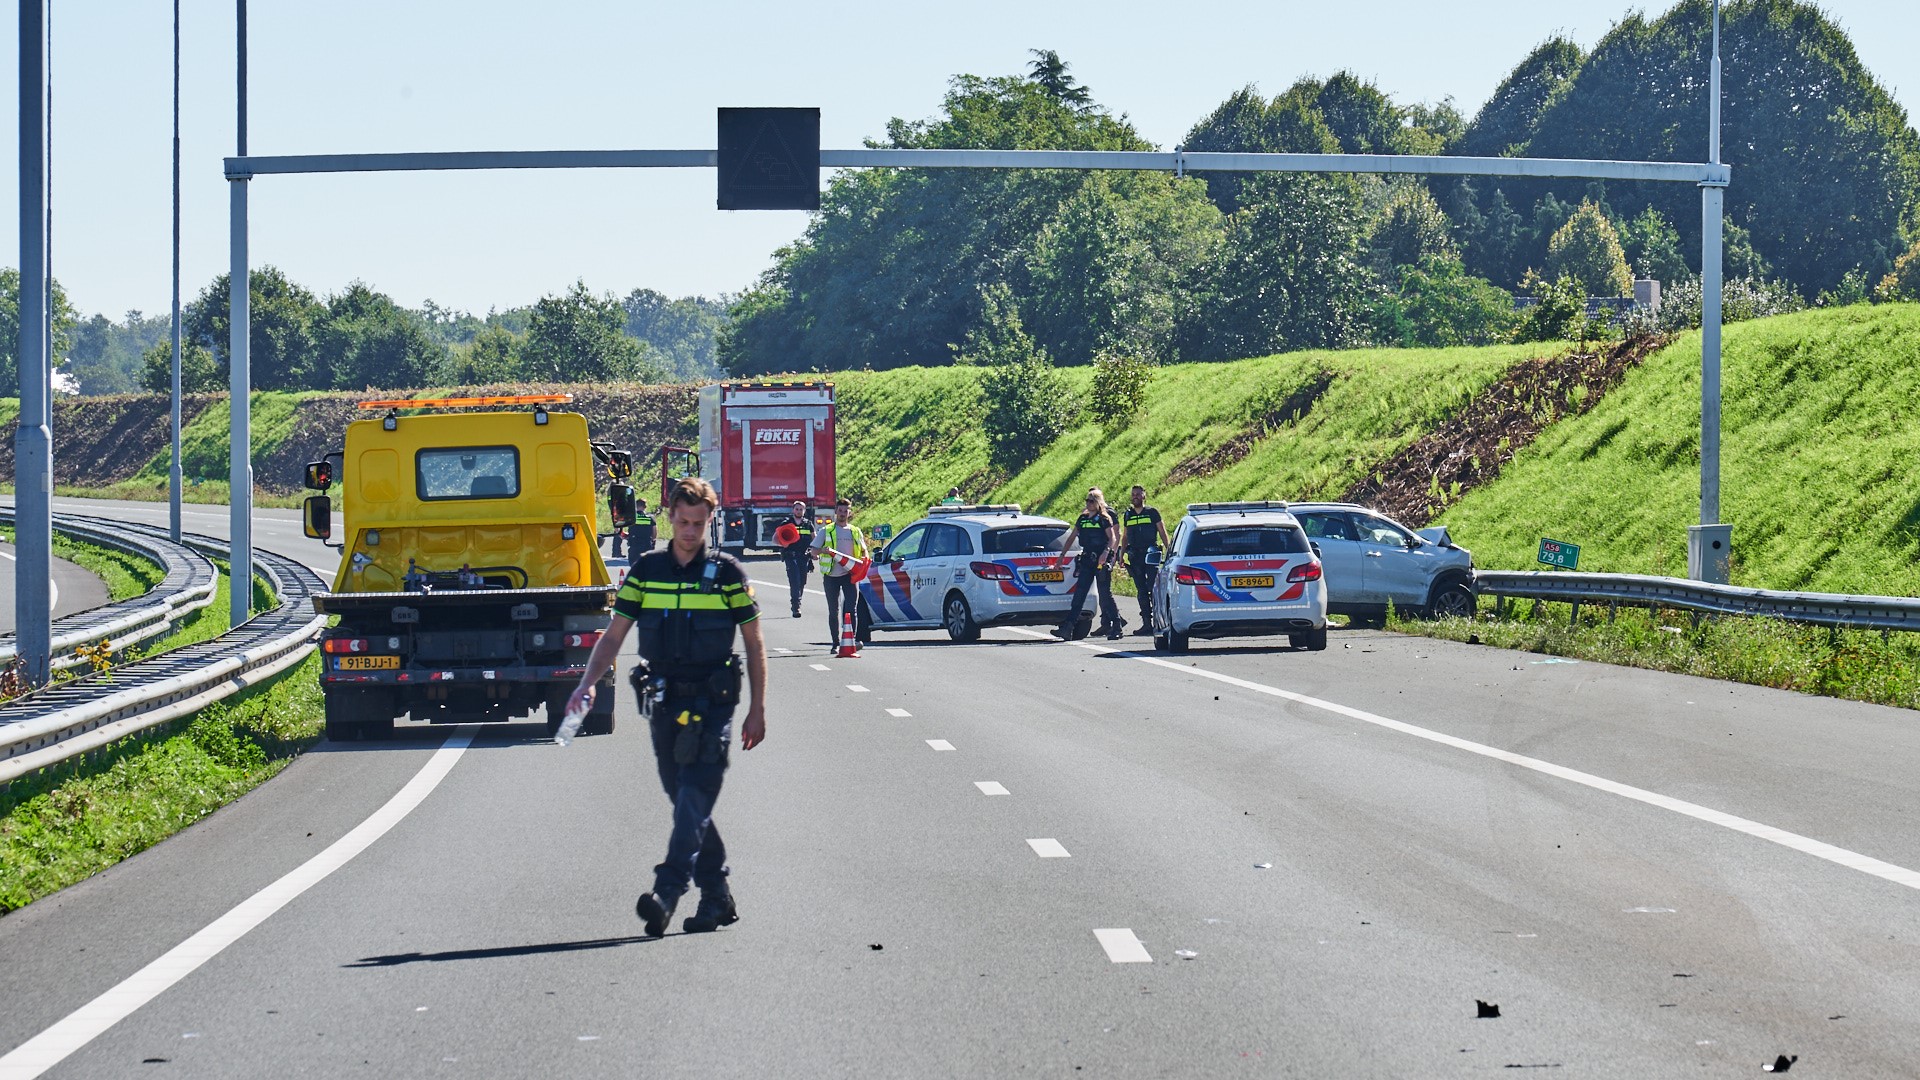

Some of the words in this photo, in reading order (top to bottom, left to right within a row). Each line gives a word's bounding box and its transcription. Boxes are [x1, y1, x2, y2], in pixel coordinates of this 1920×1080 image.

[755, 431, 801, 441] FOKKE
[1545, 543, 1560, 552] A58
[1031, 573, 1060, 581] XJ-593-P
[1233, 577, 1270, 586] TS-896-T
